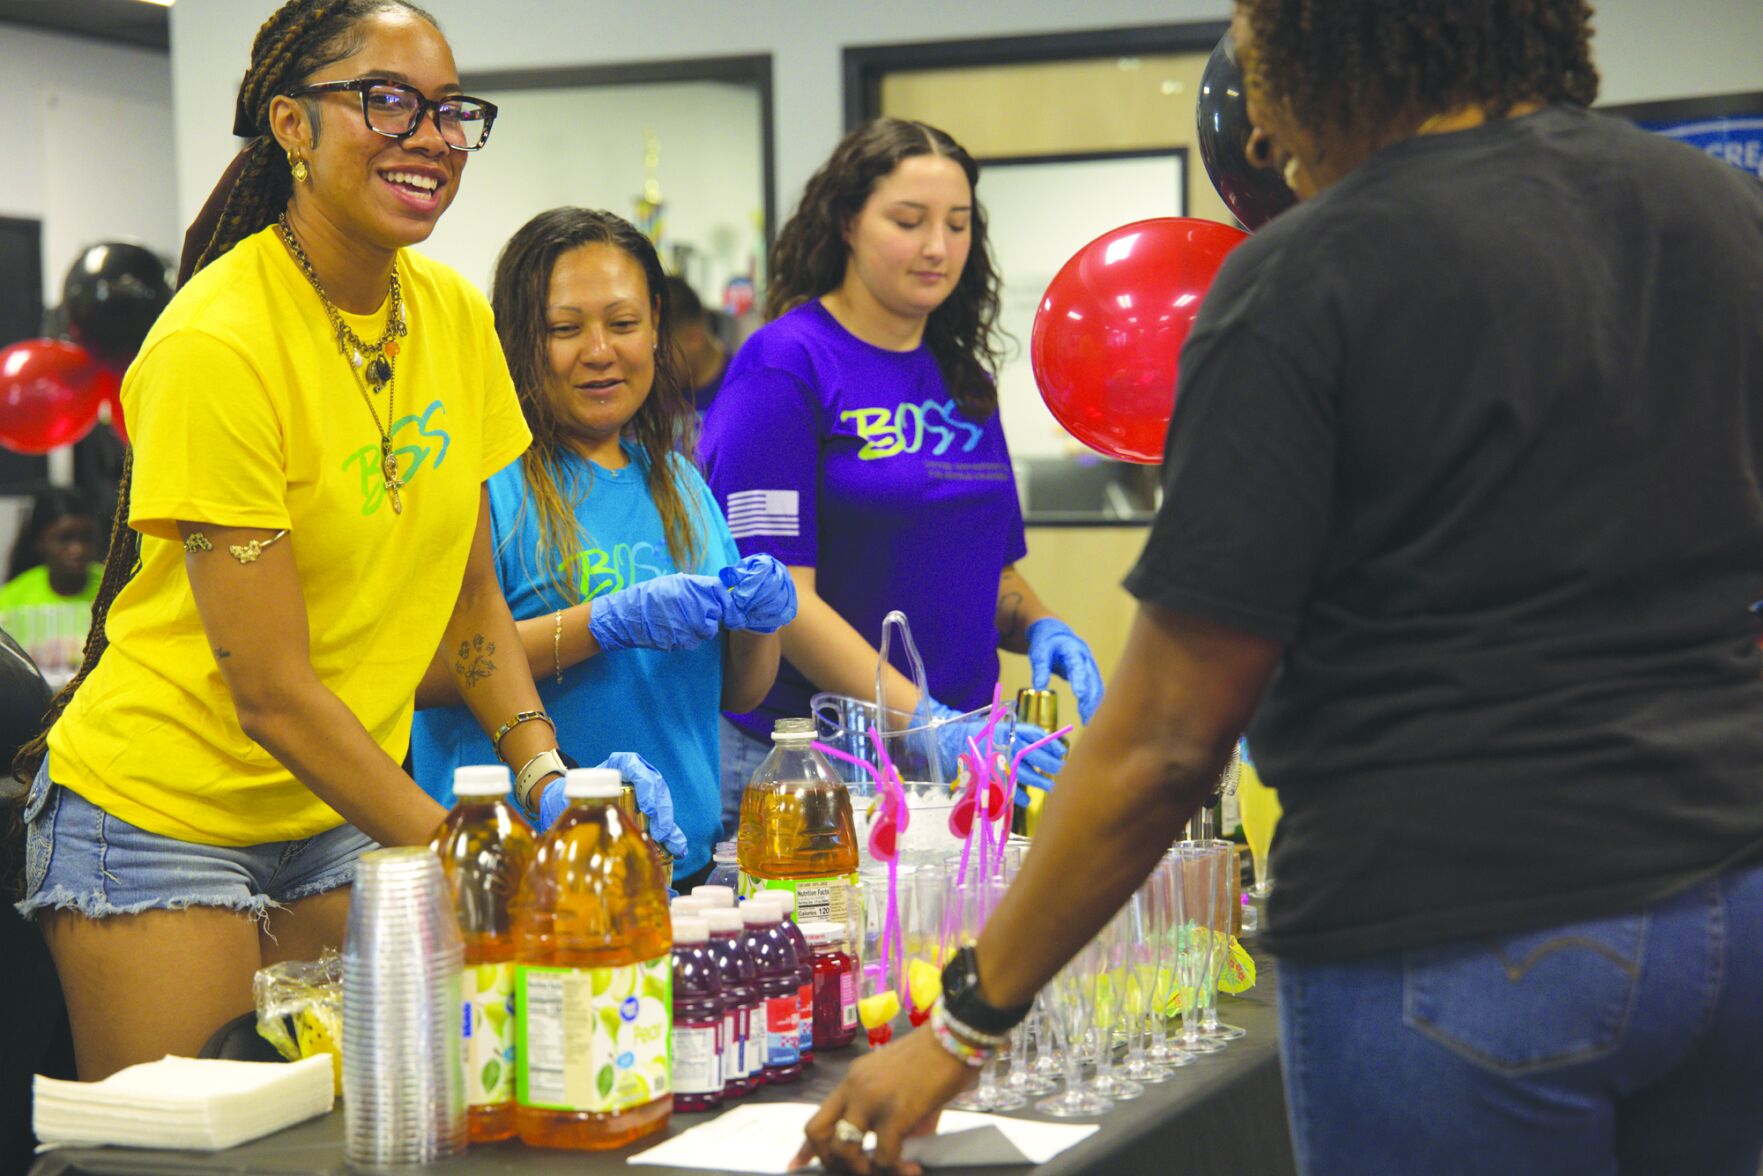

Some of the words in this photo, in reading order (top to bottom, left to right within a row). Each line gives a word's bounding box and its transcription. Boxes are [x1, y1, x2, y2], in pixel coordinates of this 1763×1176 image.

[341, 400, 450, 516] BSS
[840, 399, 983, 460] BOSS
[558, 541, 668, 604] BOS
[819, 907, 830, 915] 120
